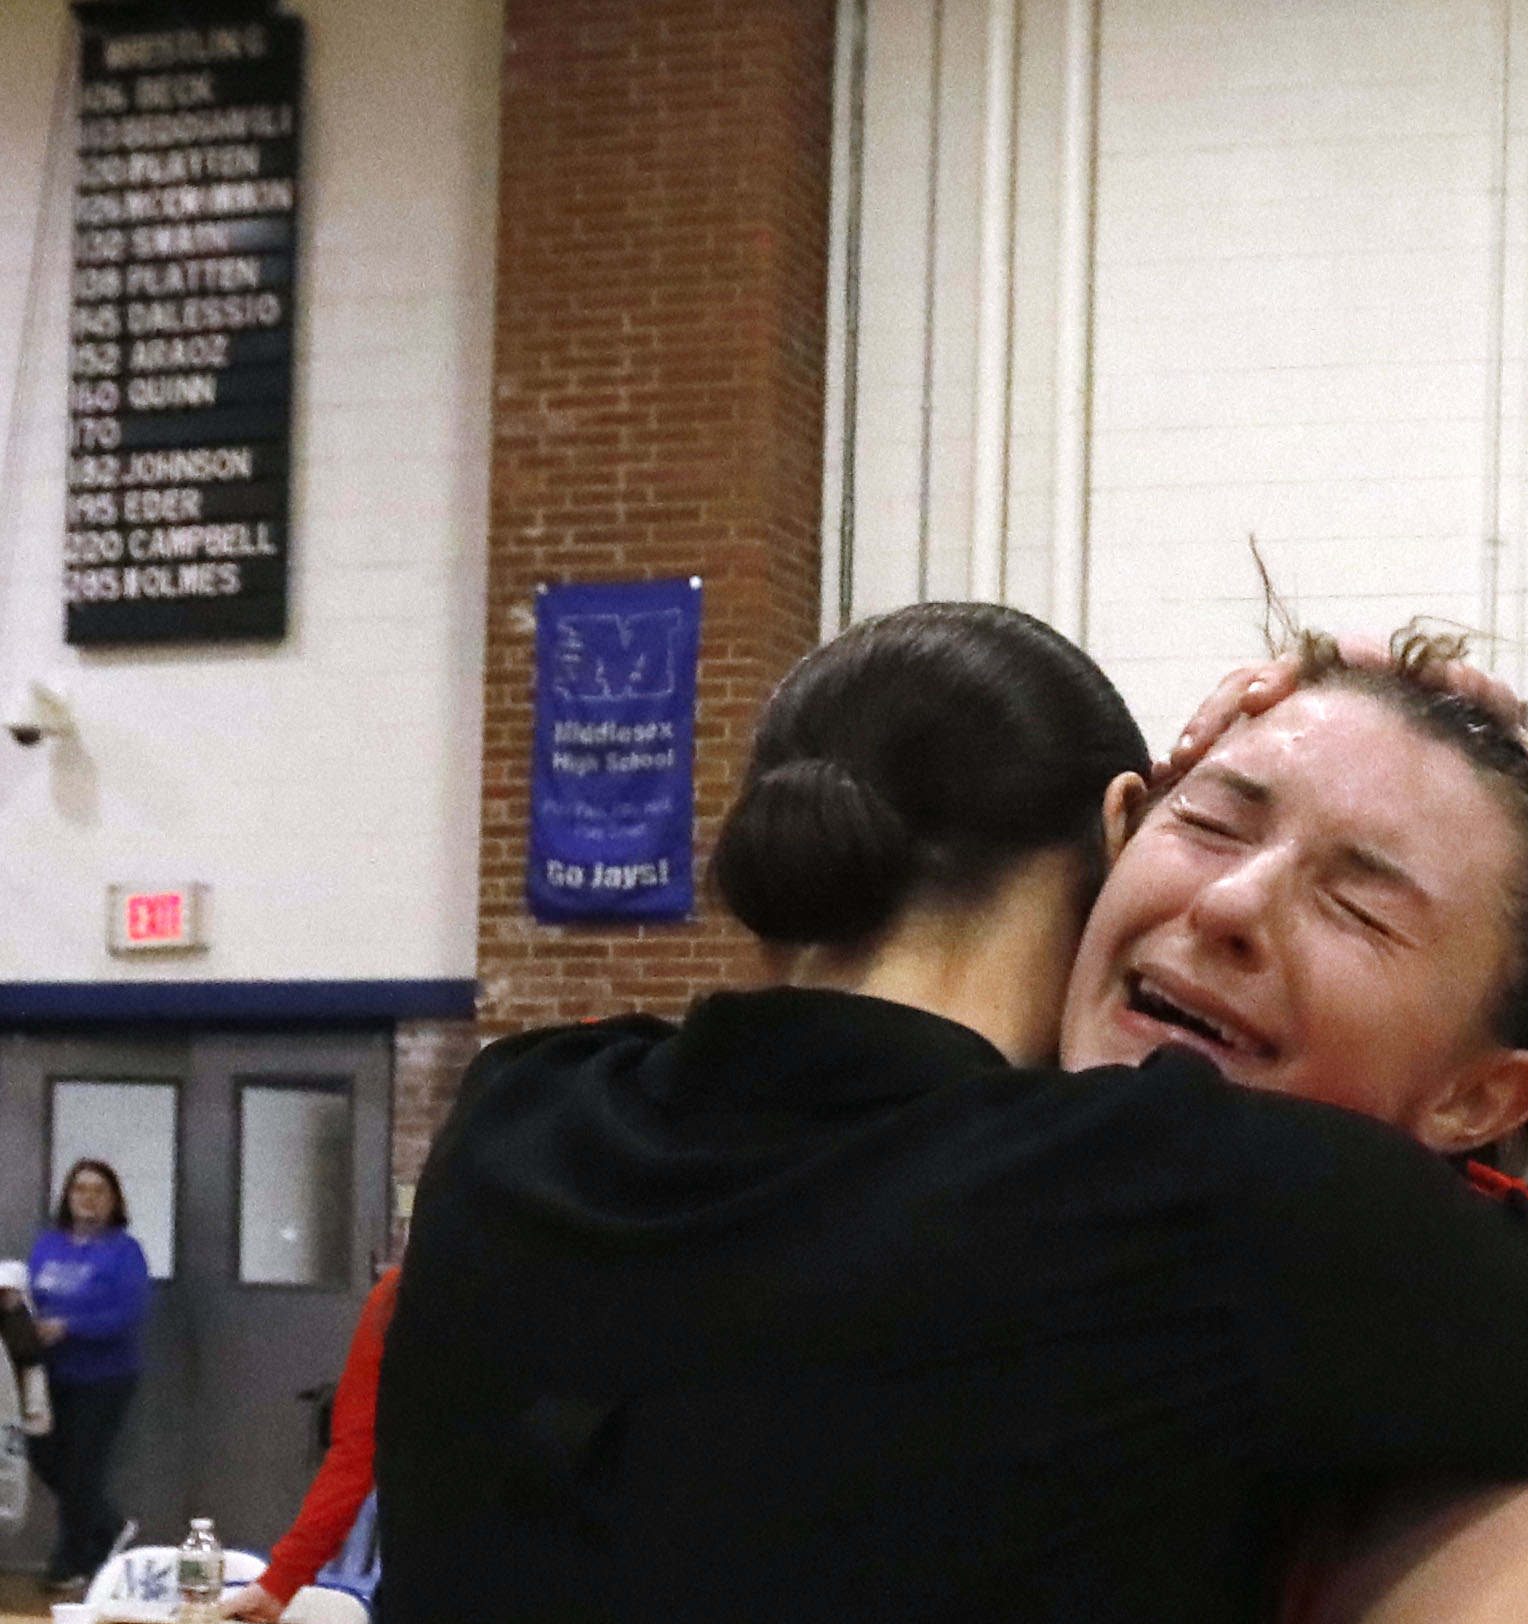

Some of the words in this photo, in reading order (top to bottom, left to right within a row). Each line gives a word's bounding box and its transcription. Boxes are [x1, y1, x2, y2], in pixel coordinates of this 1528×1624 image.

[125, 256, 260, 296] PLATTEN
[126, 372, 218, 410] QUINN
[119, 447, 253, 485] JOHNSON
[122, 486, 203, 523] EDER
[125, 520, 278, 559] CAMPBELL
[546, 858, 585, 890] Go
[591, 857, 669, 890] Jays!
[127, 893, 182, 941] EXIT
